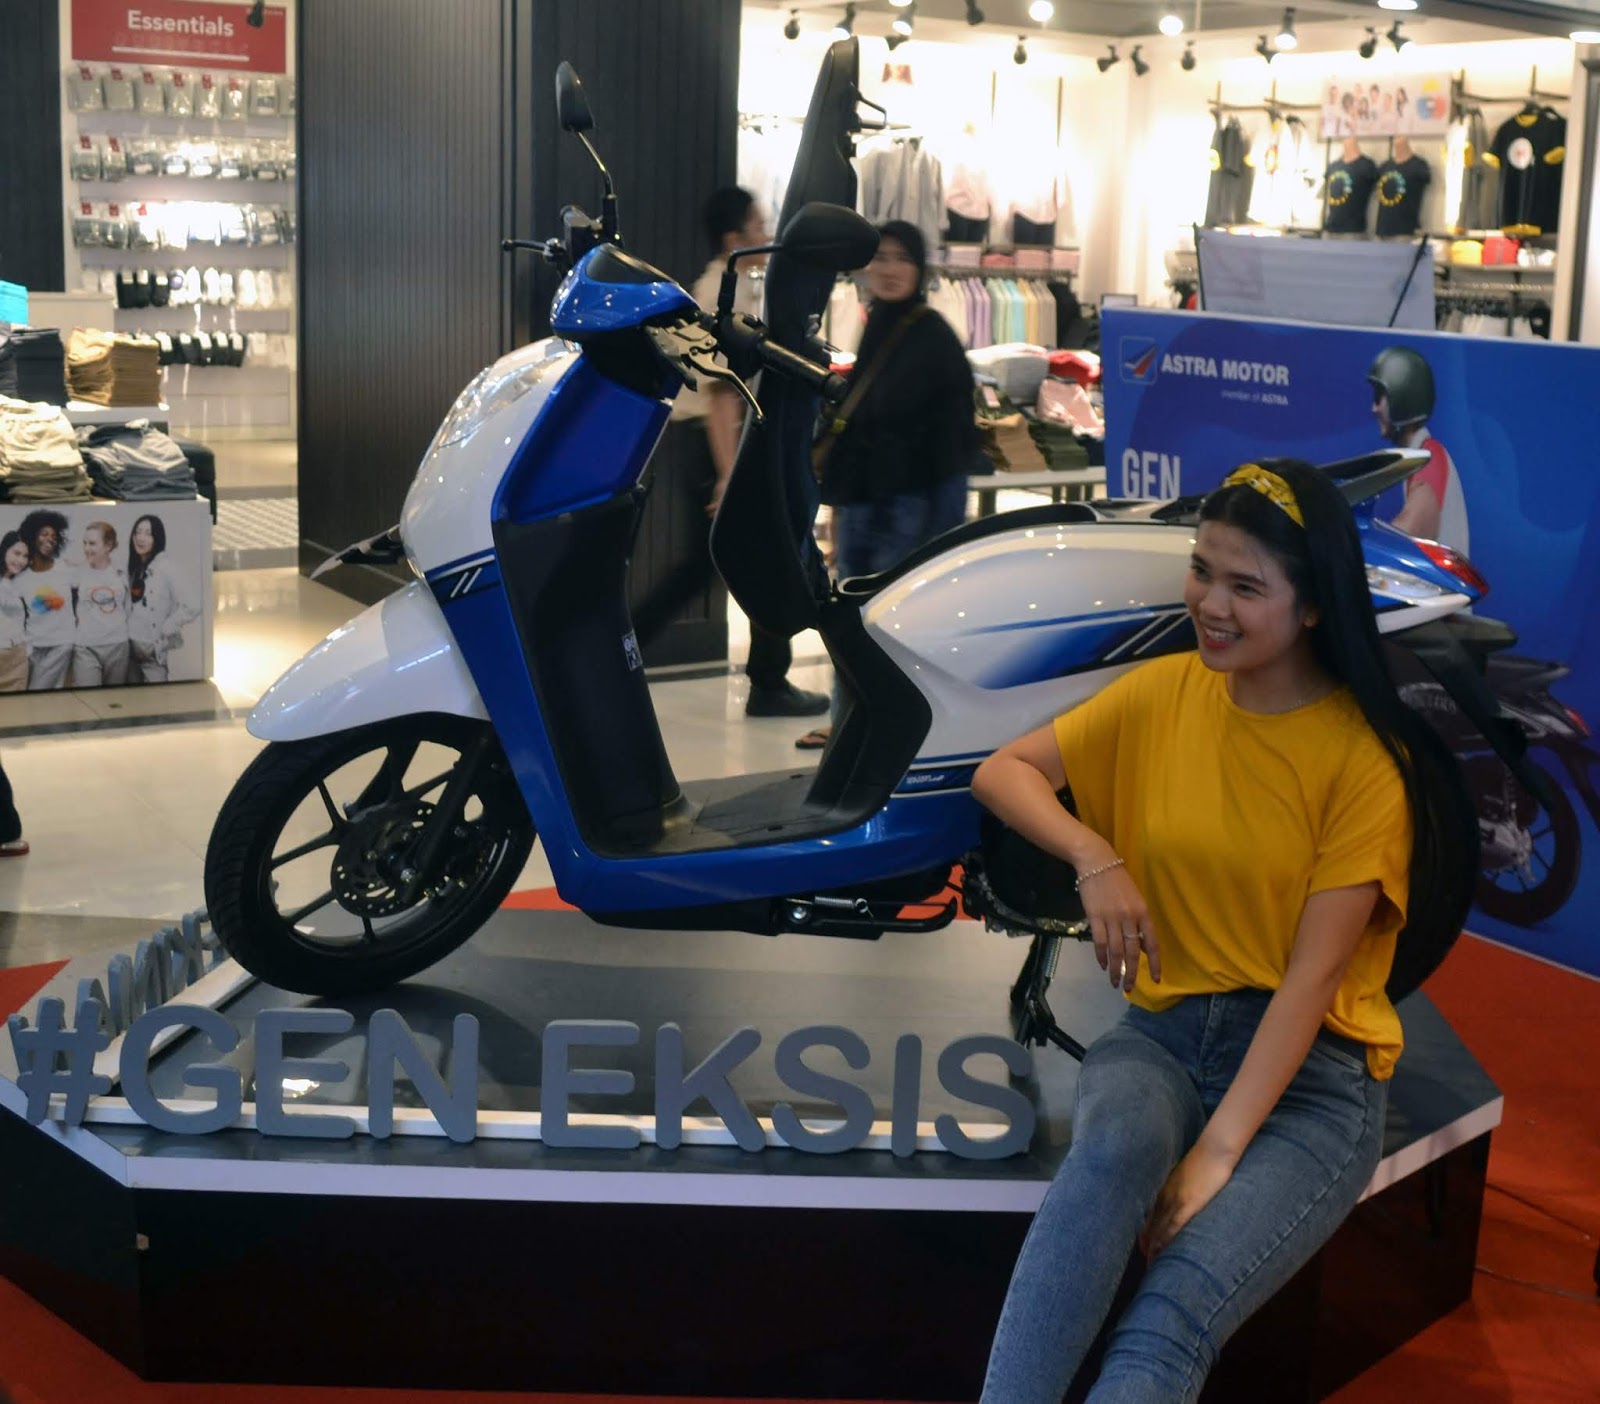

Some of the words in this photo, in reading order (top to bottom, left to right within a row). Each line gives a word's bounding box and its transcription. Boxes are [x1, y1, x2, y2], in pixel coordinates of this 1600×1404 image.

[128, 9, 234, 37] Essentials
[1161, 353, 1218, 378] ASTRA
[1221, 359, 1290, 386] MOTOR
[1262, 393, 1289, 405] ASTRA
[1122, 448, 1181, 500] GEN
[16, 996, 479, 1143] #GEN
[540, 1019, 1036, 1160] EKSIS
